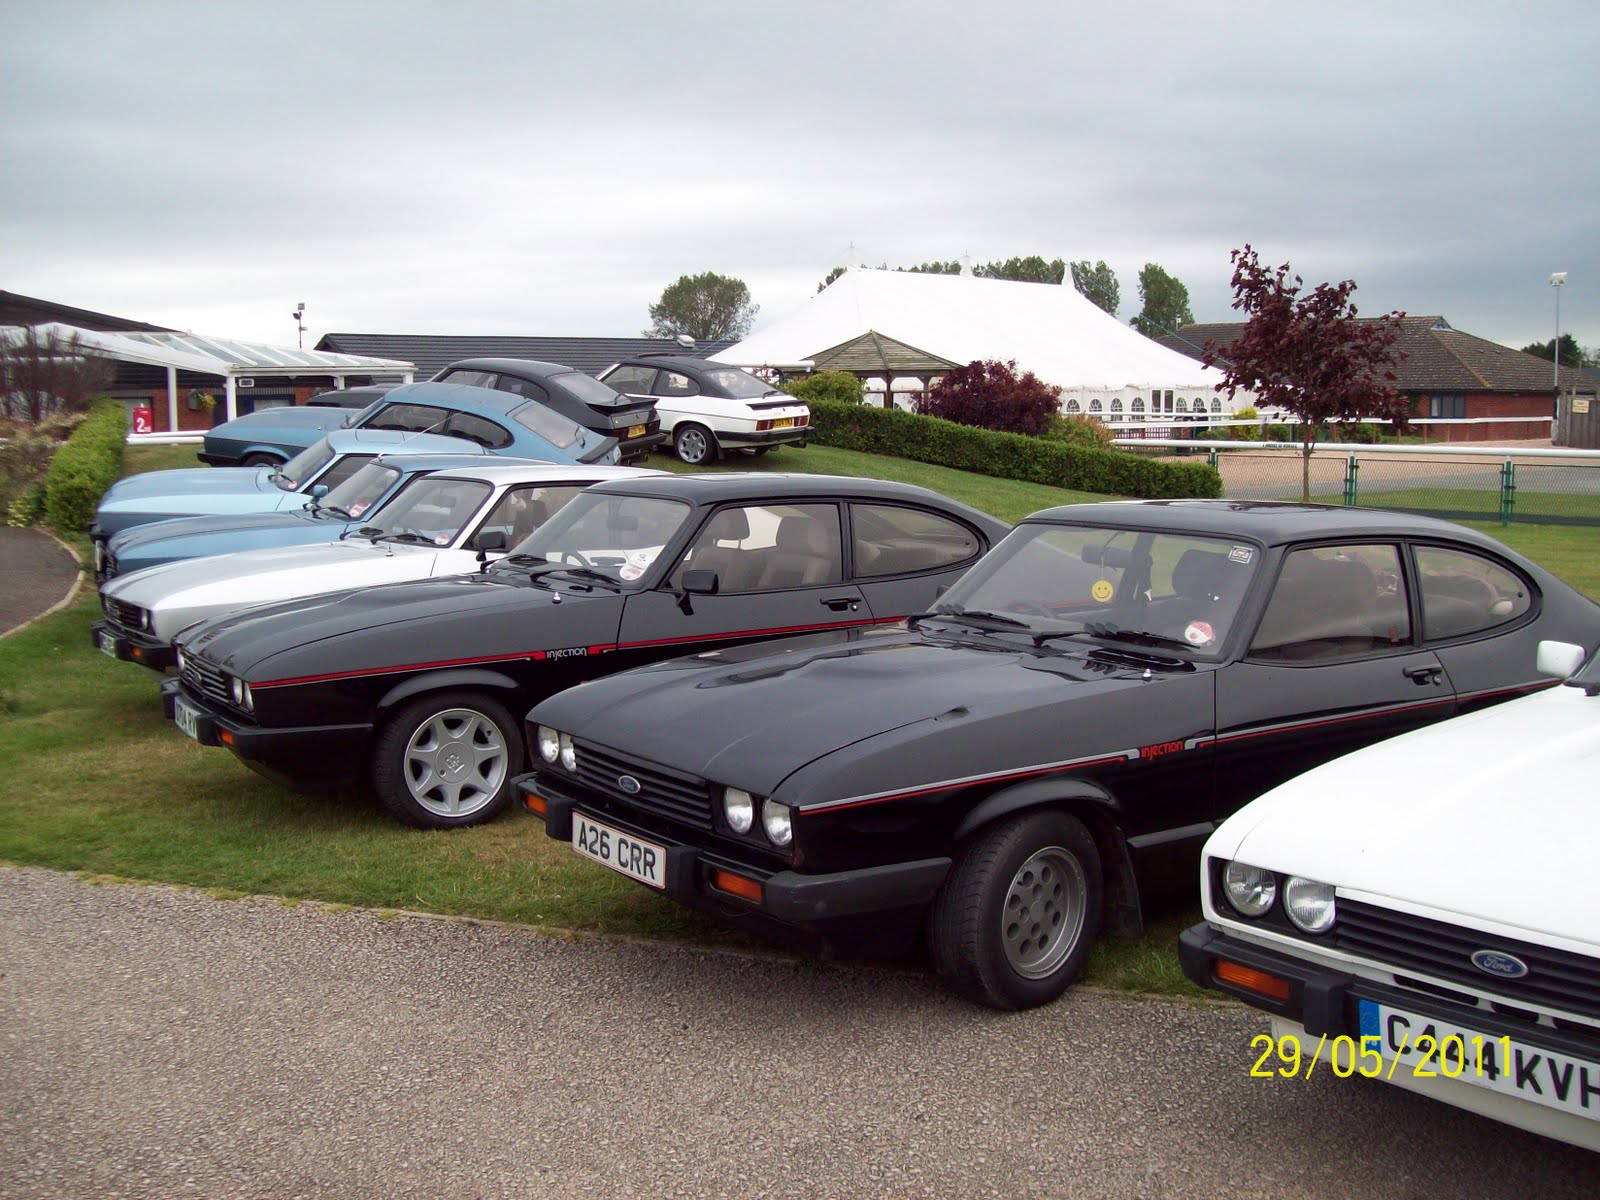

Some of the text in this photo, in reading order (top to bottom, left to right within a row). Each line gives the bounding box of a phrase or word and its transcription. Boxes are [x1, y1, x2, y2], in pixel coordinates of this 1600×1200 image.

[578, 821, 656, 880] A26 CRR
[1483, 954, 1513, 973] Ford
[1515, 1049, 1600, 1108] KVH
